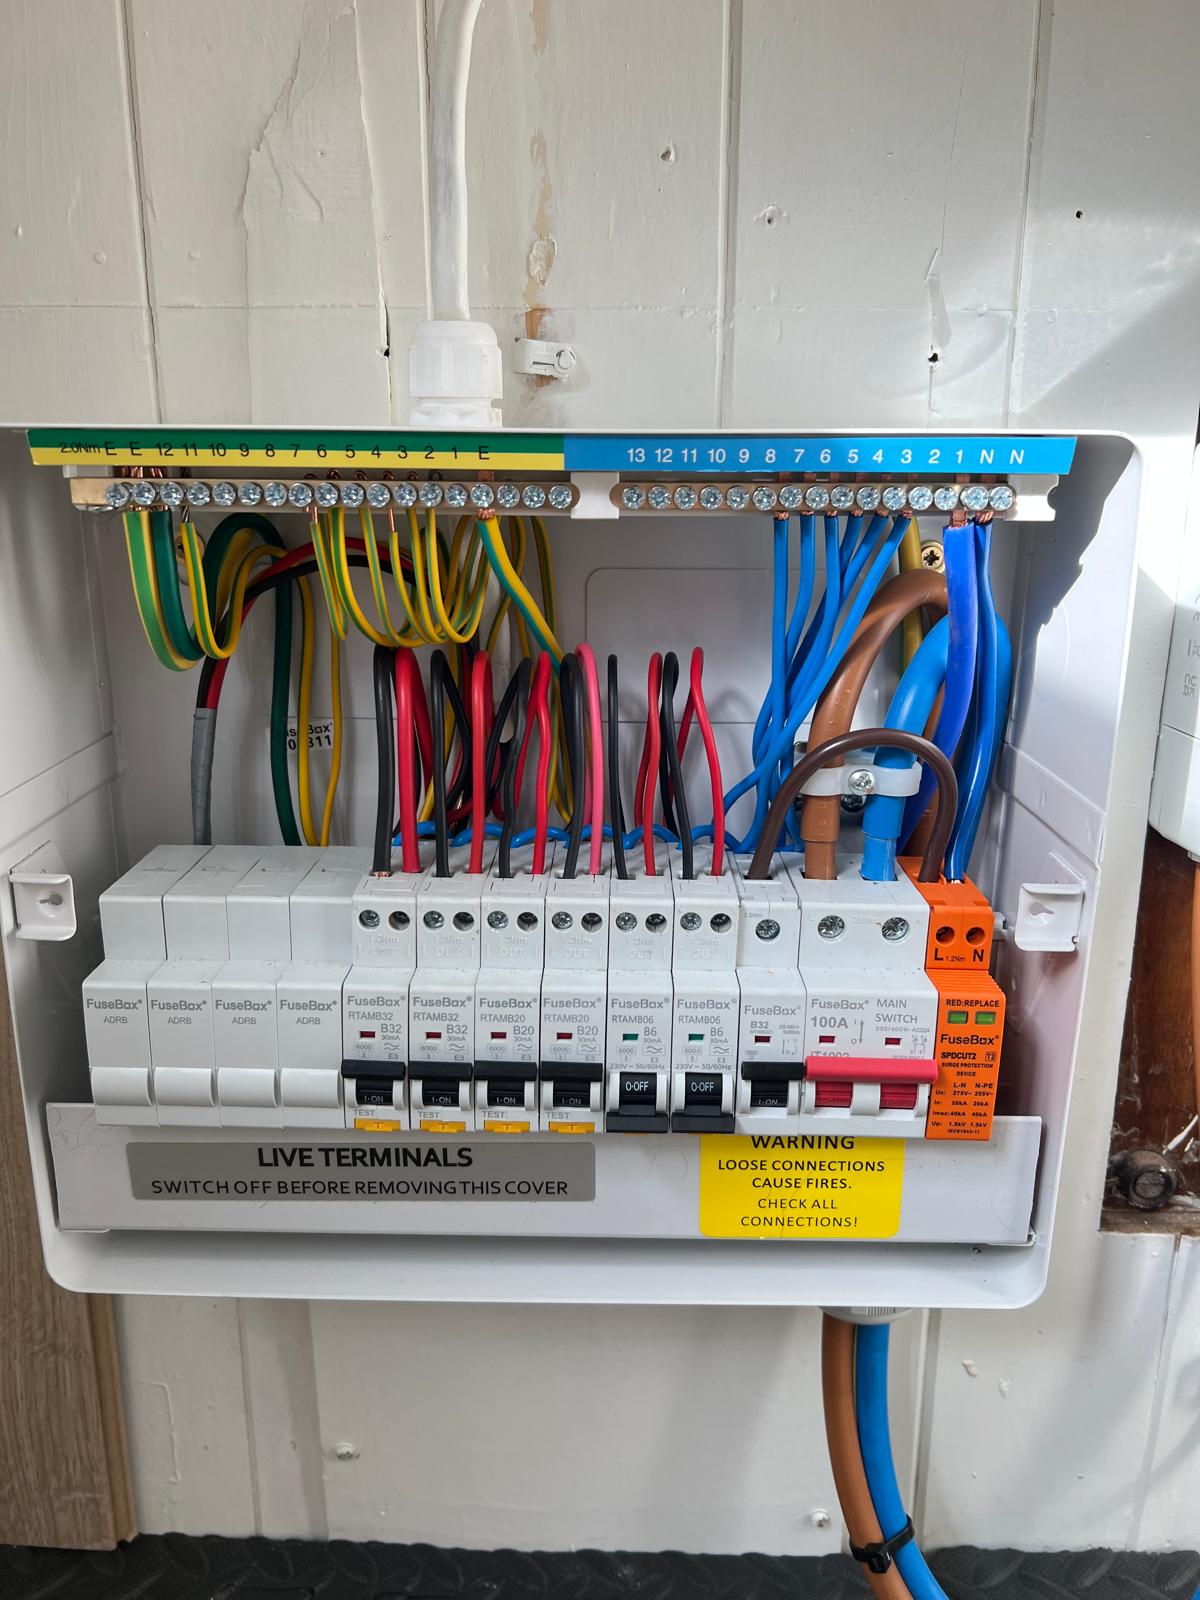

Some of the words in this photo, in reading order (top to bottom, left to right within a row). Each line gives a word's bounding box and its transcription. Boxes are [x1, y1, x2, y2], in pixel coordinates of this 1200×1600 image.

[60, 442, 101, 454] 2.0Nm
[105, 441, 117, 456] E
[130, 441, 142, 456] E
[157, 443, 173, 456] 12
[183, 443, 198, 456] 11
[208, 443, 226, 456] 10
[240, 443, 249, 457] 9
[265, 444, 275, 457] 8
[291, 444, 300, 457] 7
[317, 444, 327, 457] 6
[346, 445, 355, 458] 5
[371, 445, 382, 458] 4
[398, 445, 408, 458] 3
[424, 446, 434, 459] 2
[451, 446, 458, 459] 1
[479, 446, 490, 460] E
[627, 448, 645, 463] 13
[654, 448, 673, 463] 12
[681, 448, 697, 463] 11
[708, 448, 726, 463] 10
[738, 449, 750, 464] 9
[765, 449, 776, 463] 8
[794, 449, 805, 463] 7
[820, 449, 831, 463] 6
[847, 449, 859, 464] 5
[872, 449, 883, 464] 4
[900, 449, 912, 464] 3
[928, 449, 940, 464] 2
[956, 449, 964, 464] 1
[979, 449, 994, 464] N
[1009, 449, 1025, 464] N
[934, 948, 944, 961] L
[973, 949, 985, 962] N
[876, 999, 907, 1009] MAIN
[104, 1016, 128, 1024] ADRB
[168, 1016, 192, 1025] ADRB
[232, 1016, 256, 1025] ADRB
[296, 1017, 321, 1025] ADRB
[348, 1011, 394, 1021] RTAMB32
[413, 1012, 459, 1021] RTAMB32
[480, 1013, 526, 1023] RTAMB20
[544, 1014, 590, 1023] RTAMB20
[612, 1014, 654, 1024] RTAMB06
[678, 1015, 721, 1024] RTAMB06
[875, 1013, 918, 1024] SWITCH
[750, 1021, 769, 1029] B32
[811, 1016, 849, 1028] 100A
[380, 1023, 402, 1033] B32
[446, 1024, 468, 1034] B32
[513, 1026, 535, 1035] B20
[577, 1026, 599, 1036] B20
[644, 1027, 657, 1036] B6
[710, 1027, 724, 1036] B6
[941, 1051, 976, 1060] SPDCUT2
[482, 1110, 505, 1118] TEST
[546, 1111, 570, 1119] TEST
[751, 1136, 855, 1149] WARNING
[257, 1148, 314, 1167] LIVE
[318, 1148, 473, 1167] TERMINALS
[718, 1159, 767, 1171] LOOSE
[771, 1160, 885, 1172] CONNECTIONS
[151, 1180, 229, 1194] SWITCH
[234, 1180, 272, 1194] OFF
[277, 1180, 350, 1194] BEFORE
[355, 1180, 457, 1195] REMOVING
[459, 1181, 501, 1194] THIS
[504, 1181, 568, 1195] COVER
[752, 1177, 801, 1188] CAUSE
[806, 1178, 852, 1189] FIRES.
[758, 1198, 807, 1209] CHECK
[811, 1199, 838, 1209] ALL
[741, 1216, 858, 1227] CONNECTIONS!
